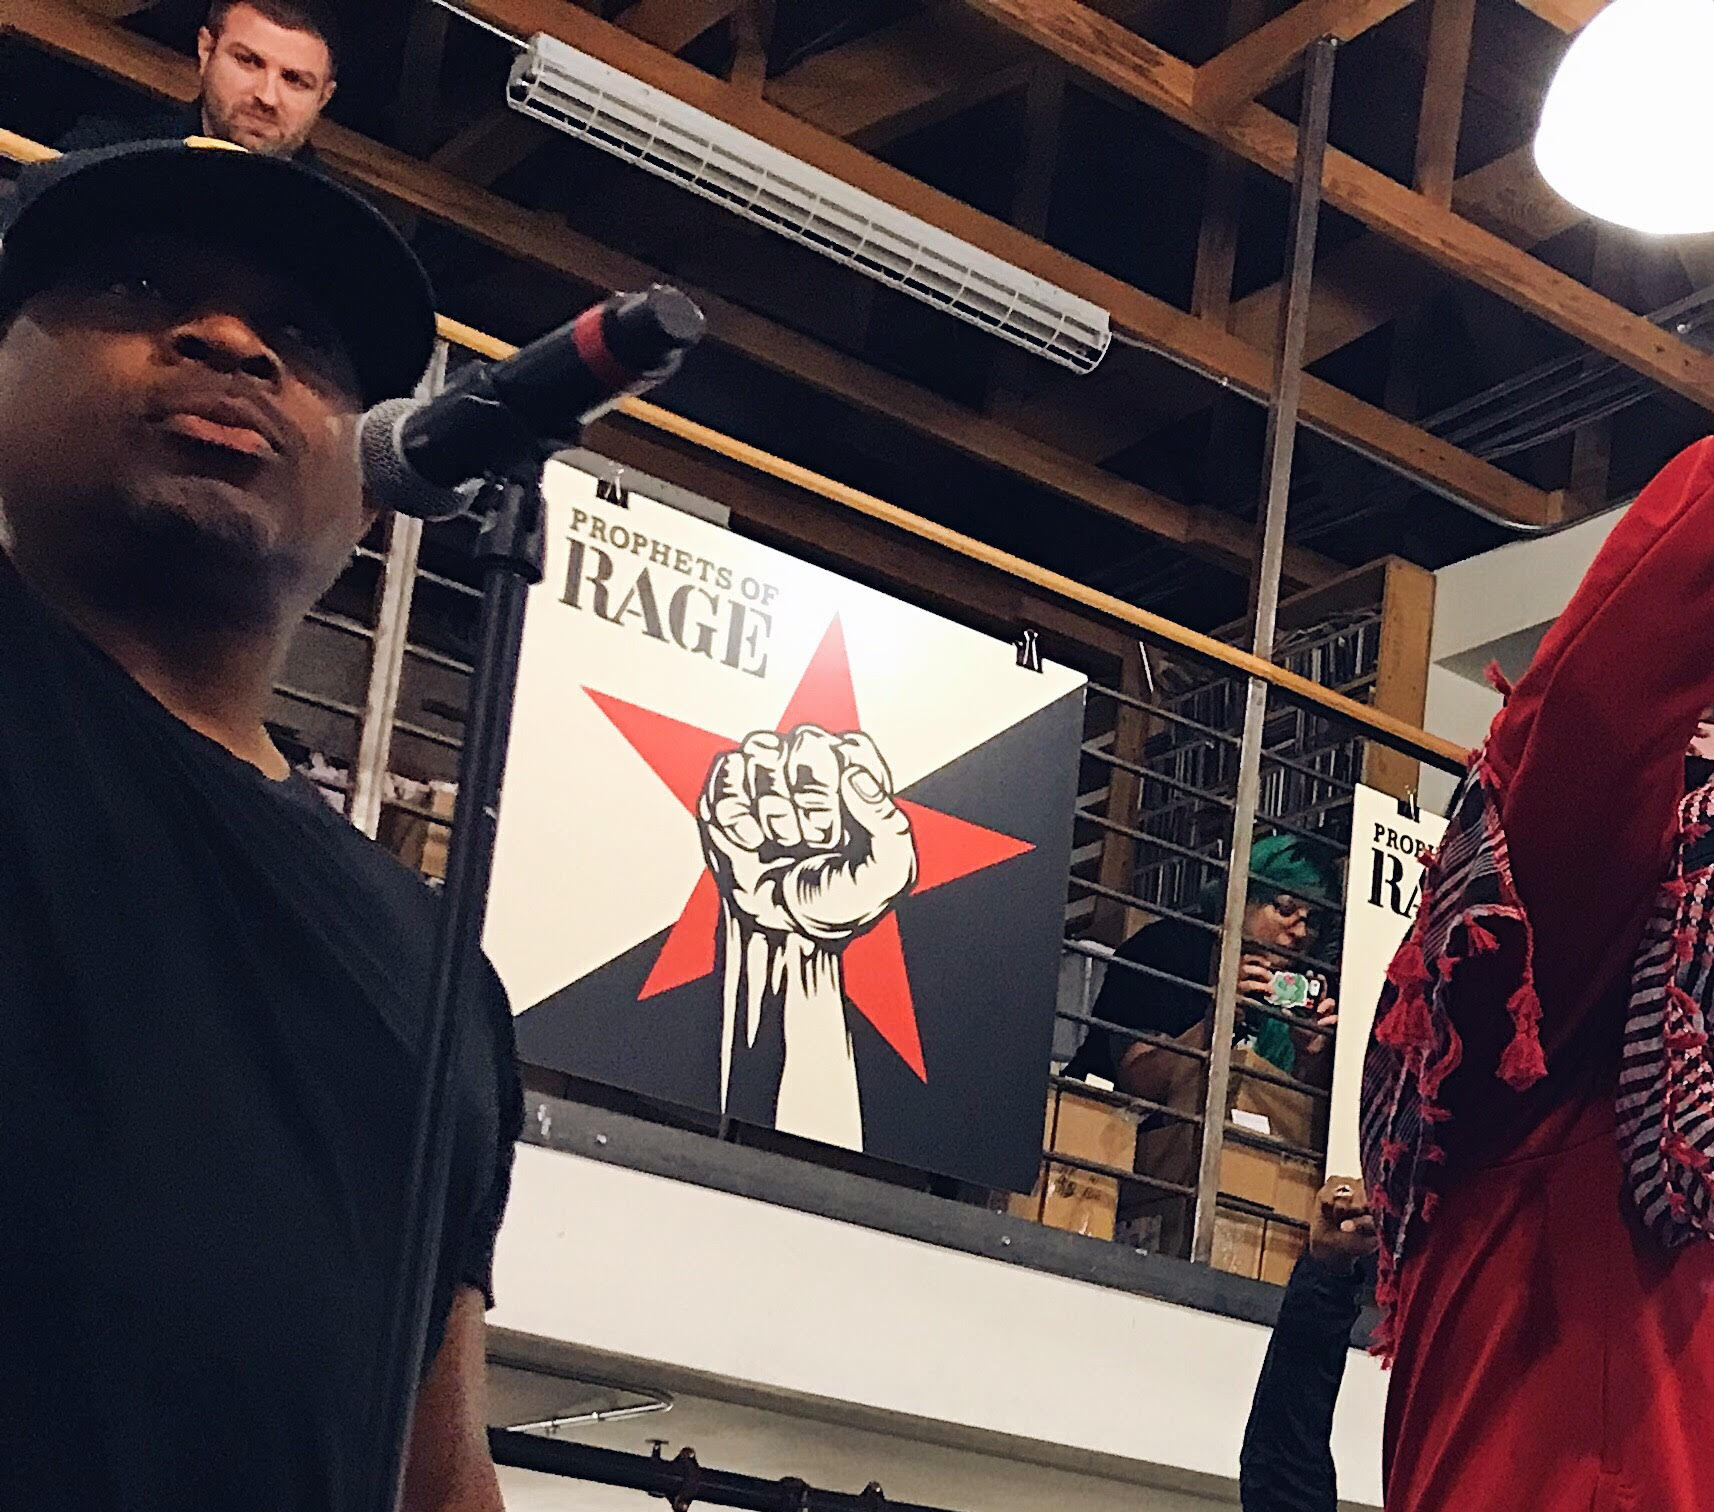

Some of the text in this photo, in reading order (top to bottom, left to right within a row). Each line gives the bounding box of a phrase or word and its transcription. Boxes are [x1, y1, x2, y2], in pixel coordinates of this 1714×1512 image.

[569, 507, 779, 606] PROPHETS OF
[558, 536, 773, 679] RAGE
[1373, 822, 1434, 858] PROP
